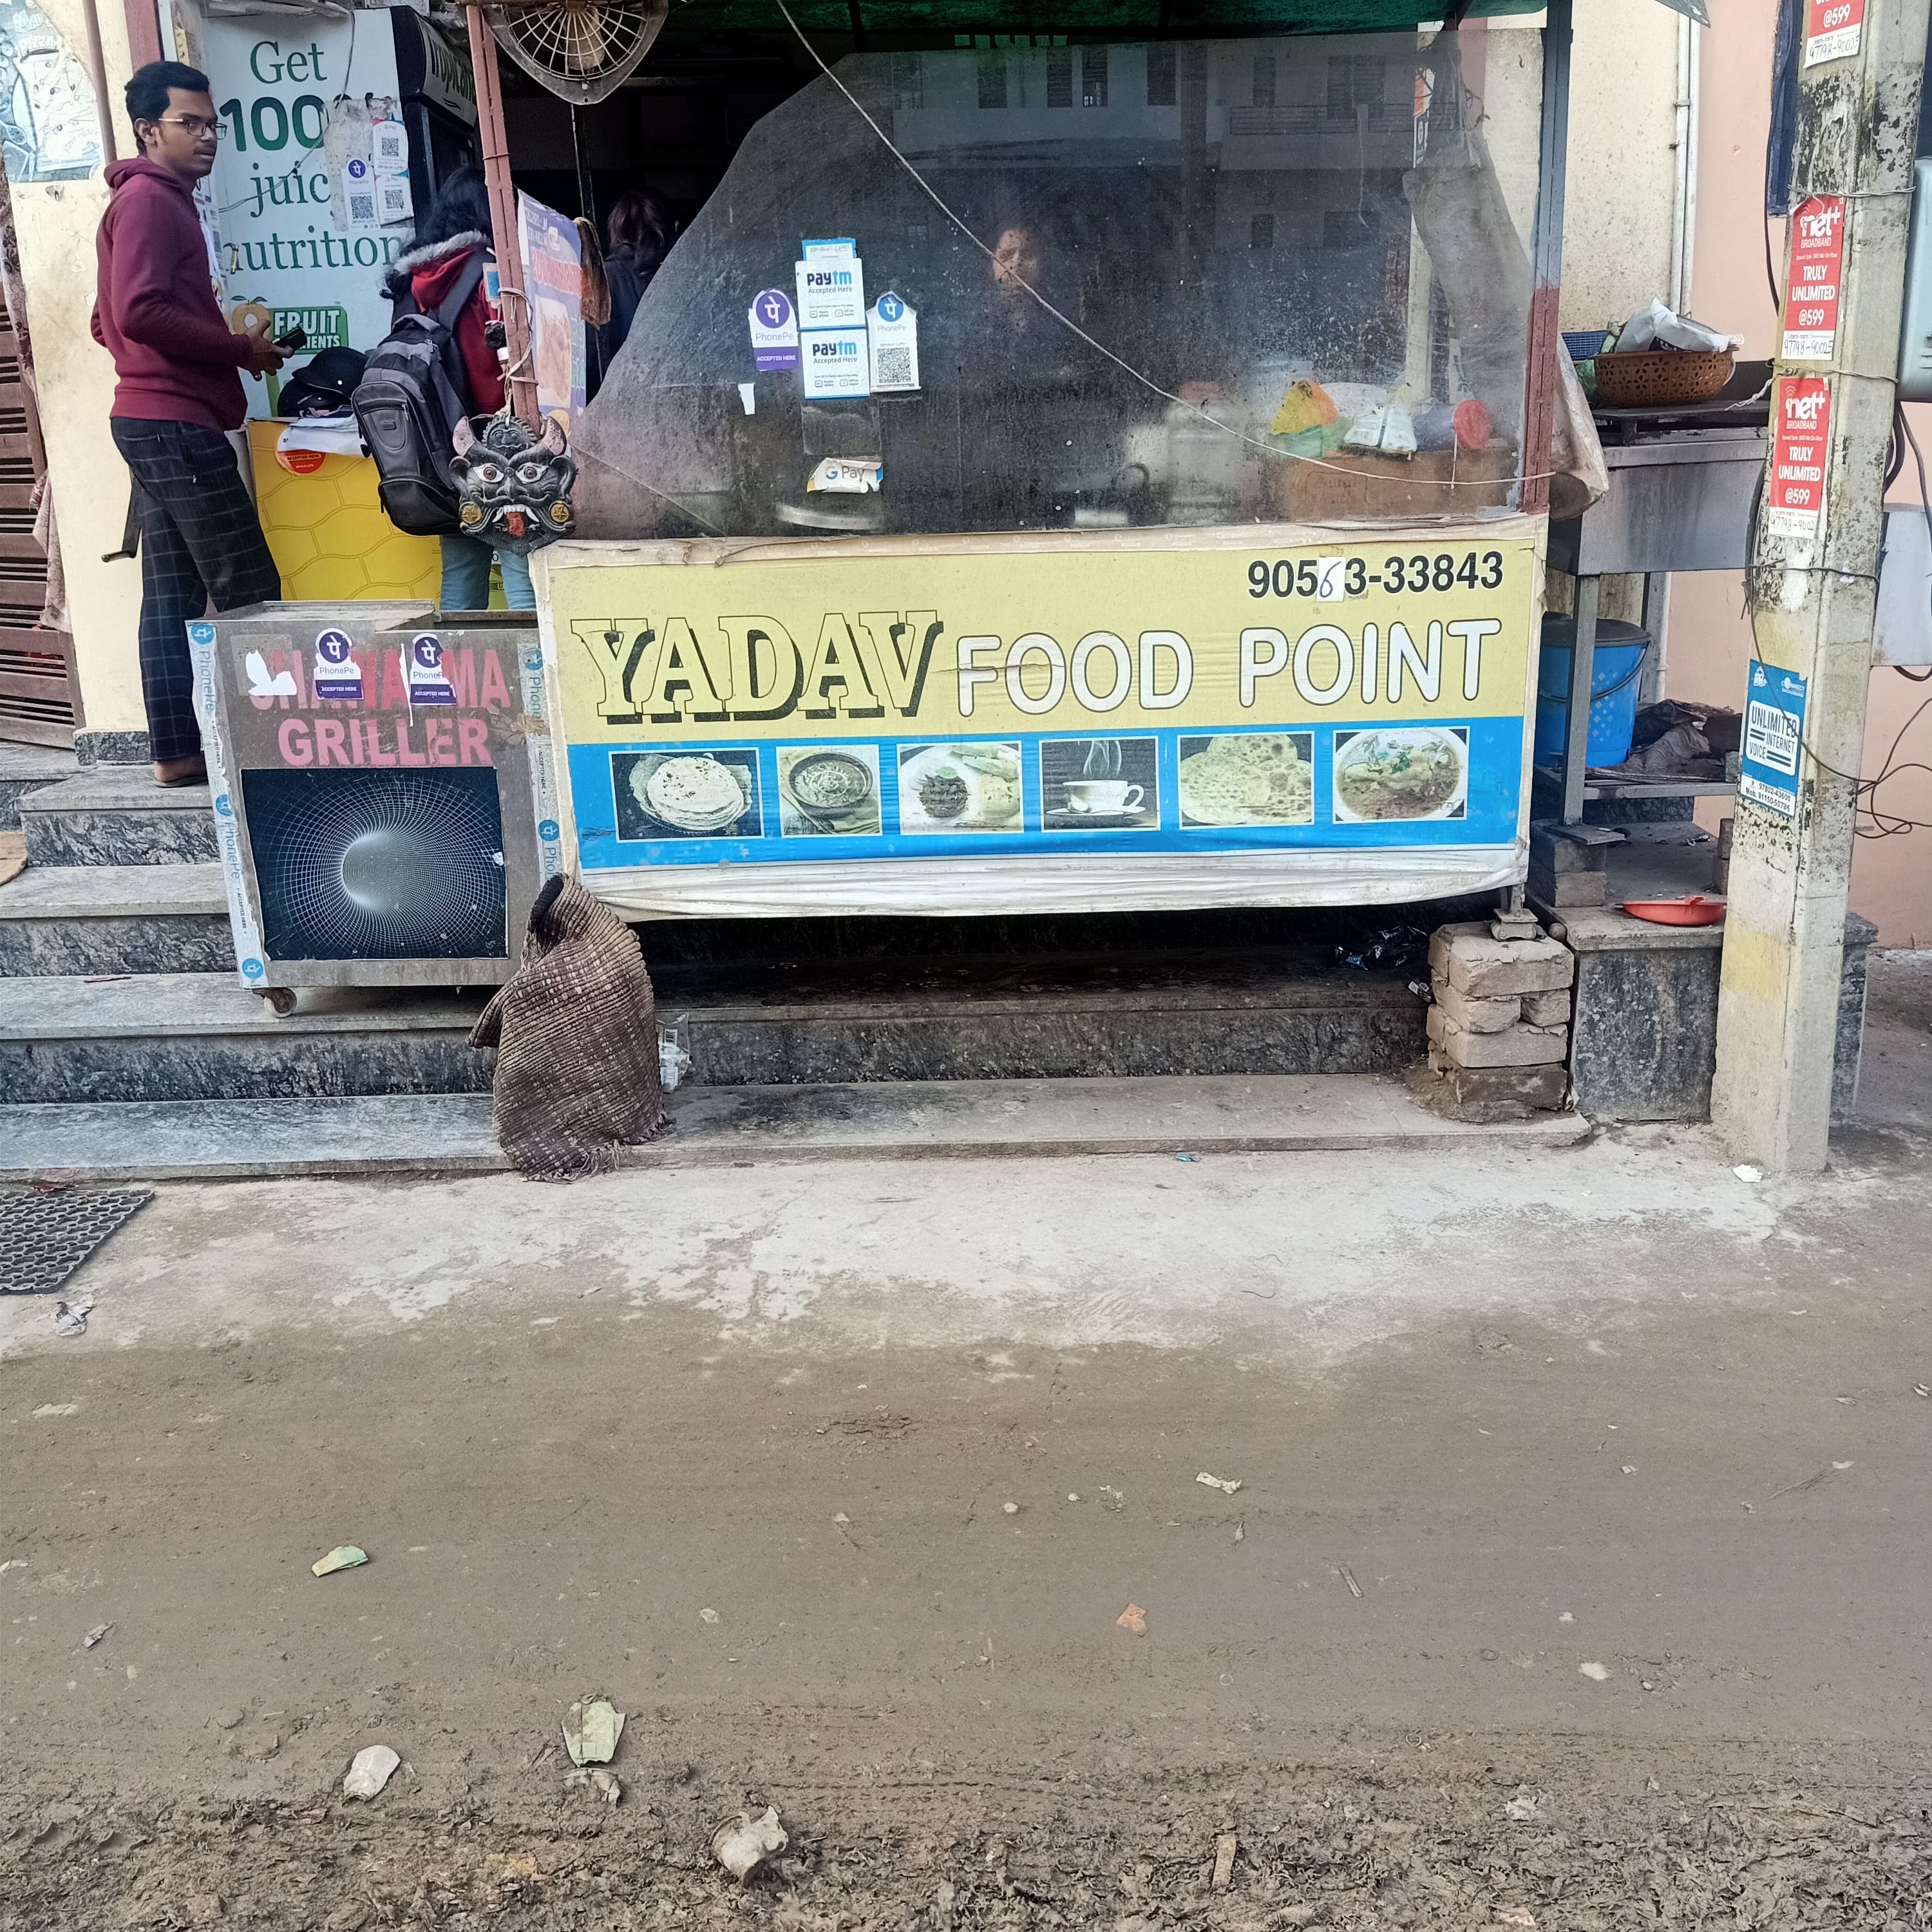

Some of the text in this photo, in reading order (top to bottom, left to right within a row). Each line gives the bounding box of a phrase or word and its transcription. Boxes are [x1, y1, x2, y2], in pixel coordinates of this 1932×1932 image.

[1824, 4, 1850, 28] @599
[250, 41, 328, 84] Get
[250, 161, 331, 218] juic
[1801, 238, 1832, 249] BROADBAND
[807, 270, 852, 286] paytm
[1803, 265, 1828, 281] TRULY
[1792, 285, 1835, 301] UNLIMITED
[274, 310, 340, 336] FRUIT
[1799, 309, 1824, 326] @599
[755, 332, 793, 341] PhonePe
[812, 341, 857, 356] paytm
[1786, 421, 1817, 430] BROADBAND
[1789, 446, 1814, 462] TRULY
[842, 466, 865, 482] Pay
[1778, 465, 1821, 482] UNLIMITED
[1785, 488, 1810, 505] @599
[1248, 551, 1504, 599] 90563-33843
[319, 666, 355, 675] PhonePe
[413, 671, 443, 679] PhoneP
[570, 610, 1502, 724] YADAV FOOD POINT
[1752, 706, 1797, 738] UNLIMITED
[278, 717, 494, 767] GRILLER
[1750, 742, 1766, 759] VOICE
[1766, 732, 1795, 755] INTERNET
[1746, 787, 1757, 797] Mob.
